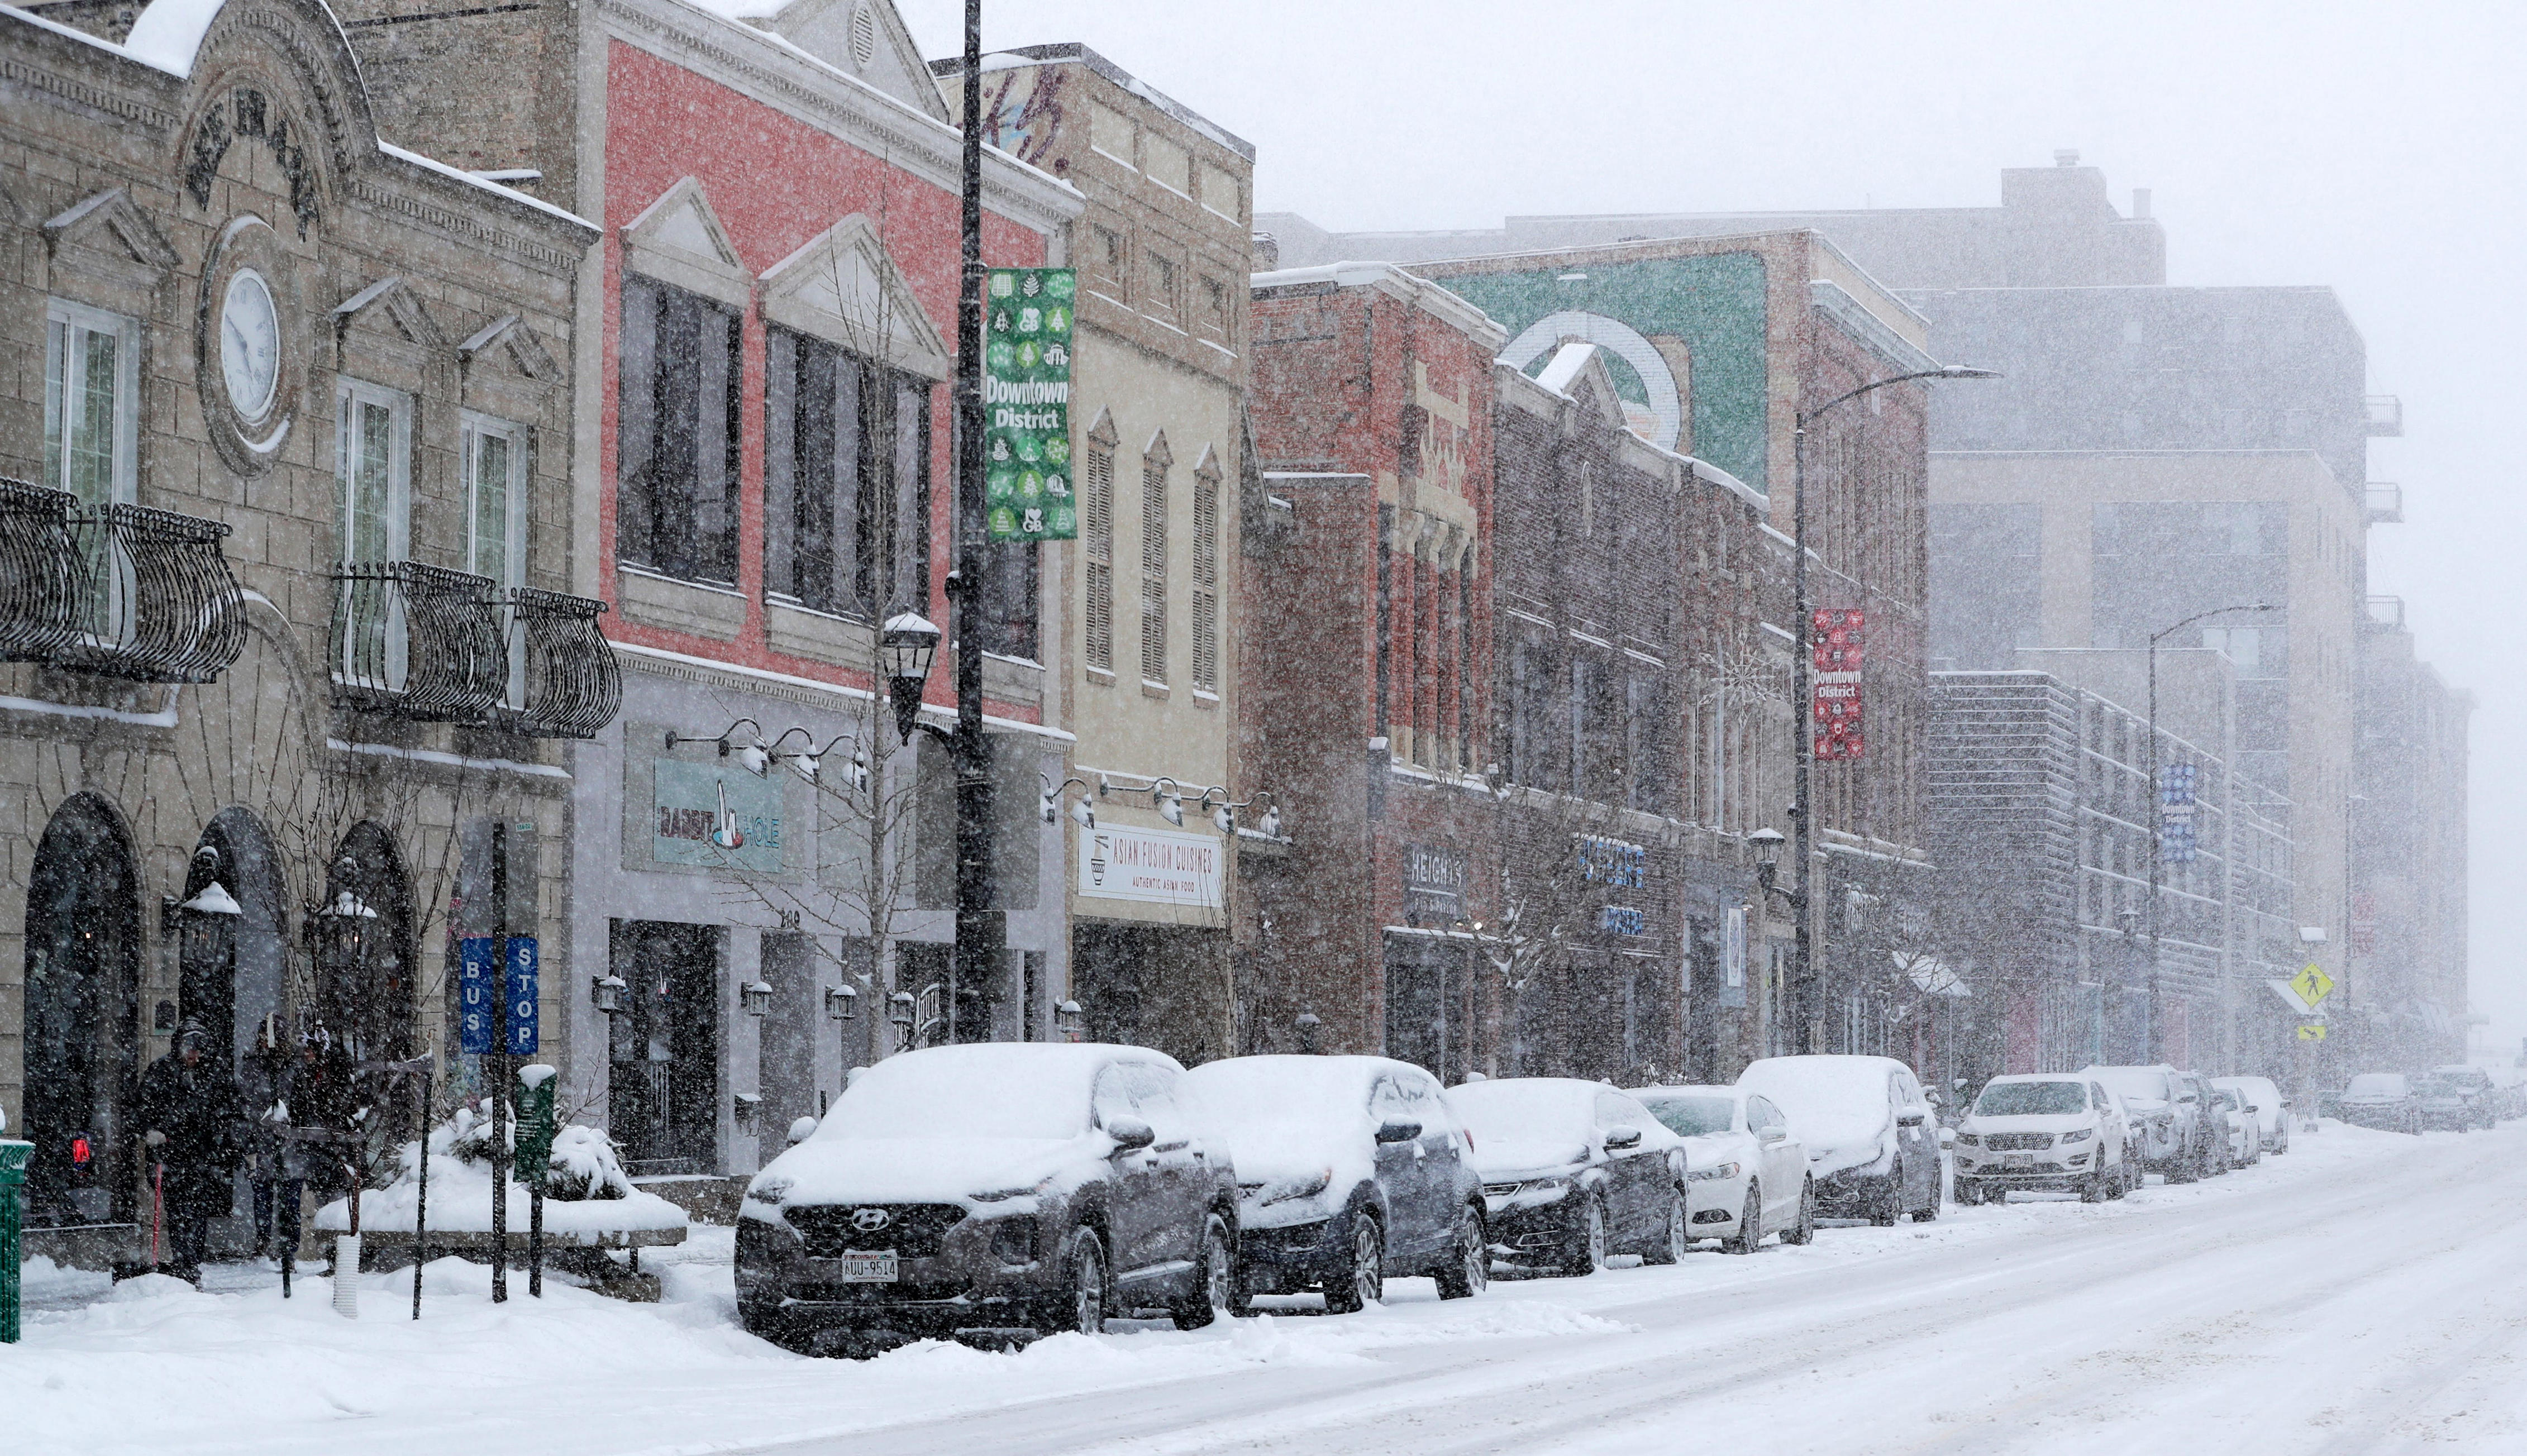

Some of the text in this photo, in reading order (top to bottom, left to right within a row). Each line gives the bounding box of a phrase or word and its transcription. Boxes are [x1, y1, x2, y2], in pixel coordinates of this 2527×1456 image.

[986, 375, 1069, 405] Downtown
[996, 409, 1059, 429] District
[1814, 669, 1861, 685] Downtown
[1819, 685, 1856, 698] District
[2162, 804, 2195, 814] Downtown
[744, 815, 780, 849] HOLE
[1113, 838, 1212, 875] ASIAN FUSION CUISINES
[1132, 876, 1194, 892] AUTHENTIC ASIAN FOOD
[466, 961, 480, 1032] BUS
[517, 947, 532, 1044] STOP
[845, 1261, 895, 1276] AUU-9514
